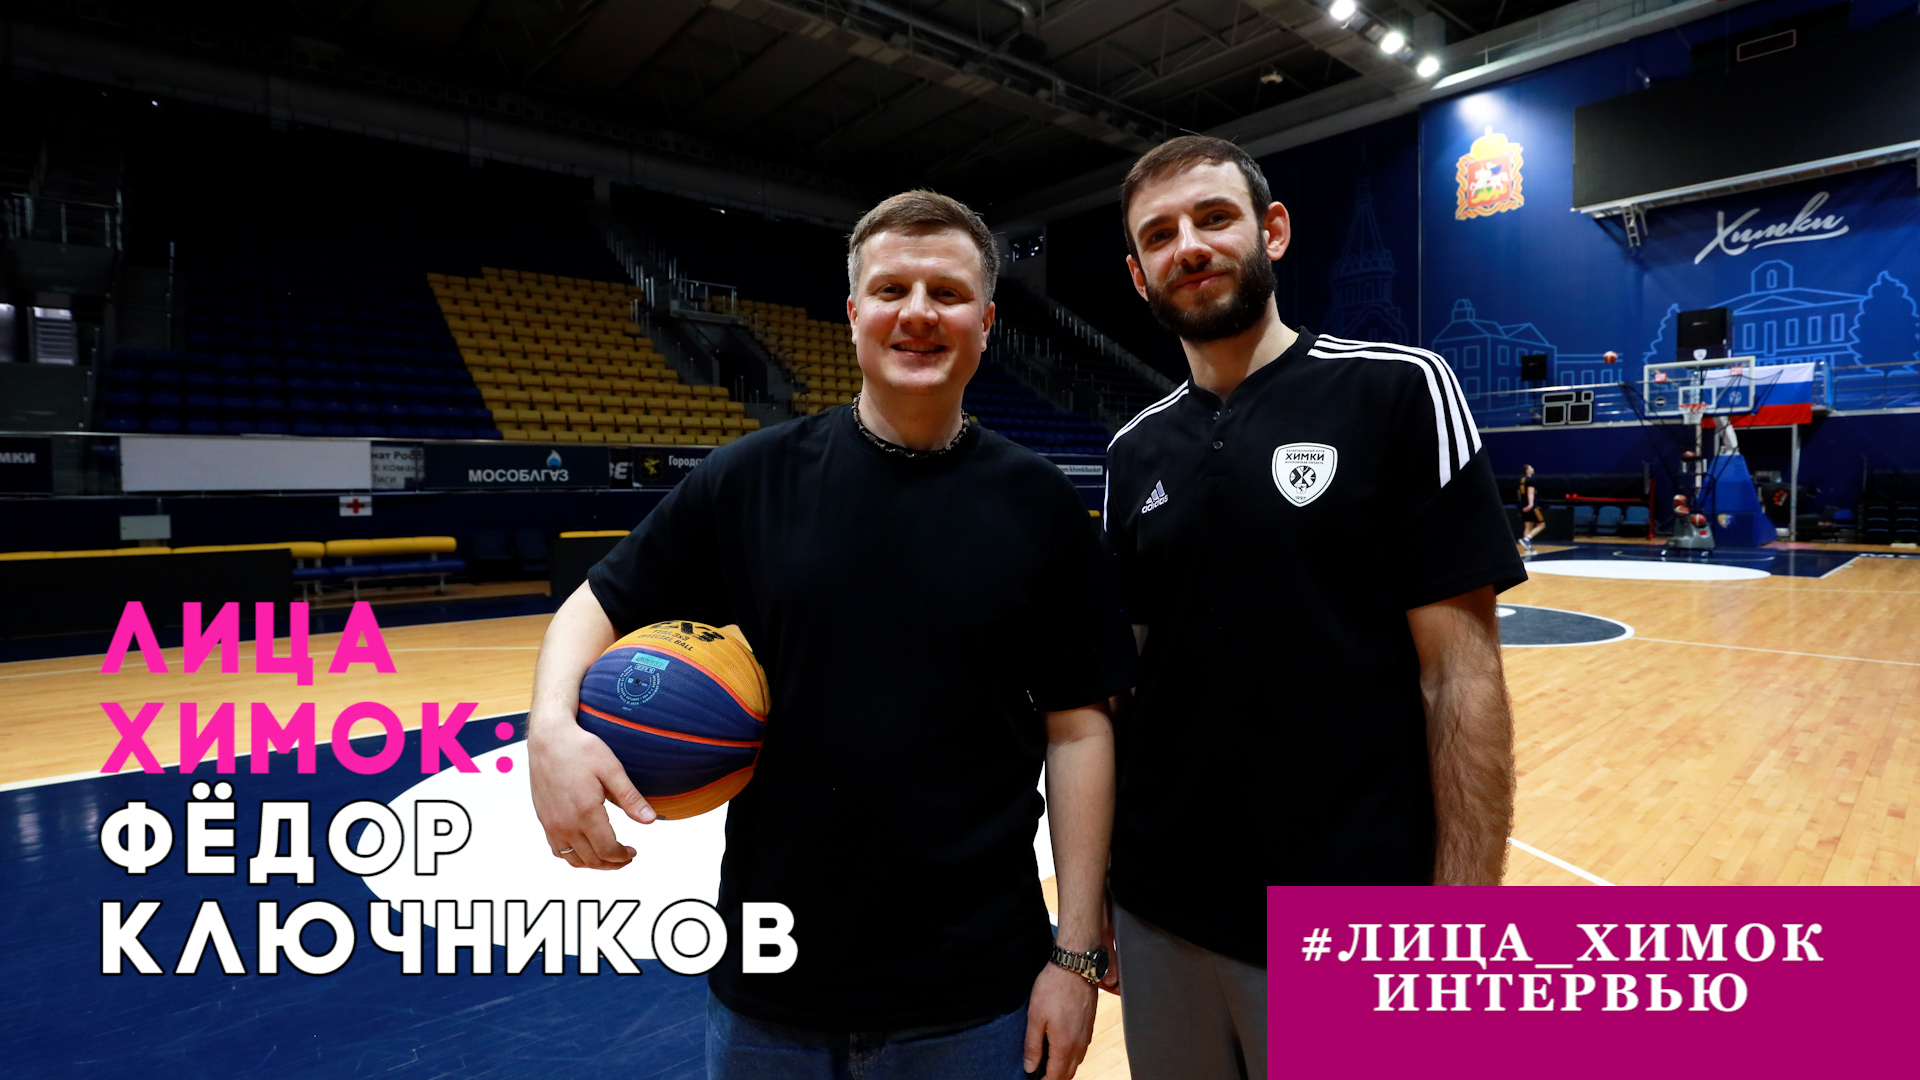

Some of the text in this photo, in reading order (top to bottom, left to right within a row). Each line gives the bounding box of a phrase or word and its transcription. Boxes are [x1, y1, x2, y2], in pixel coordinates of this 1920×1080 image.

[668, 454, 704, 469] Городс
[1285, 453, 1325, 461] ХИМКИ
[1141, 494, 1169, 514] adidas
[674, 639, 694, 652] BALL
